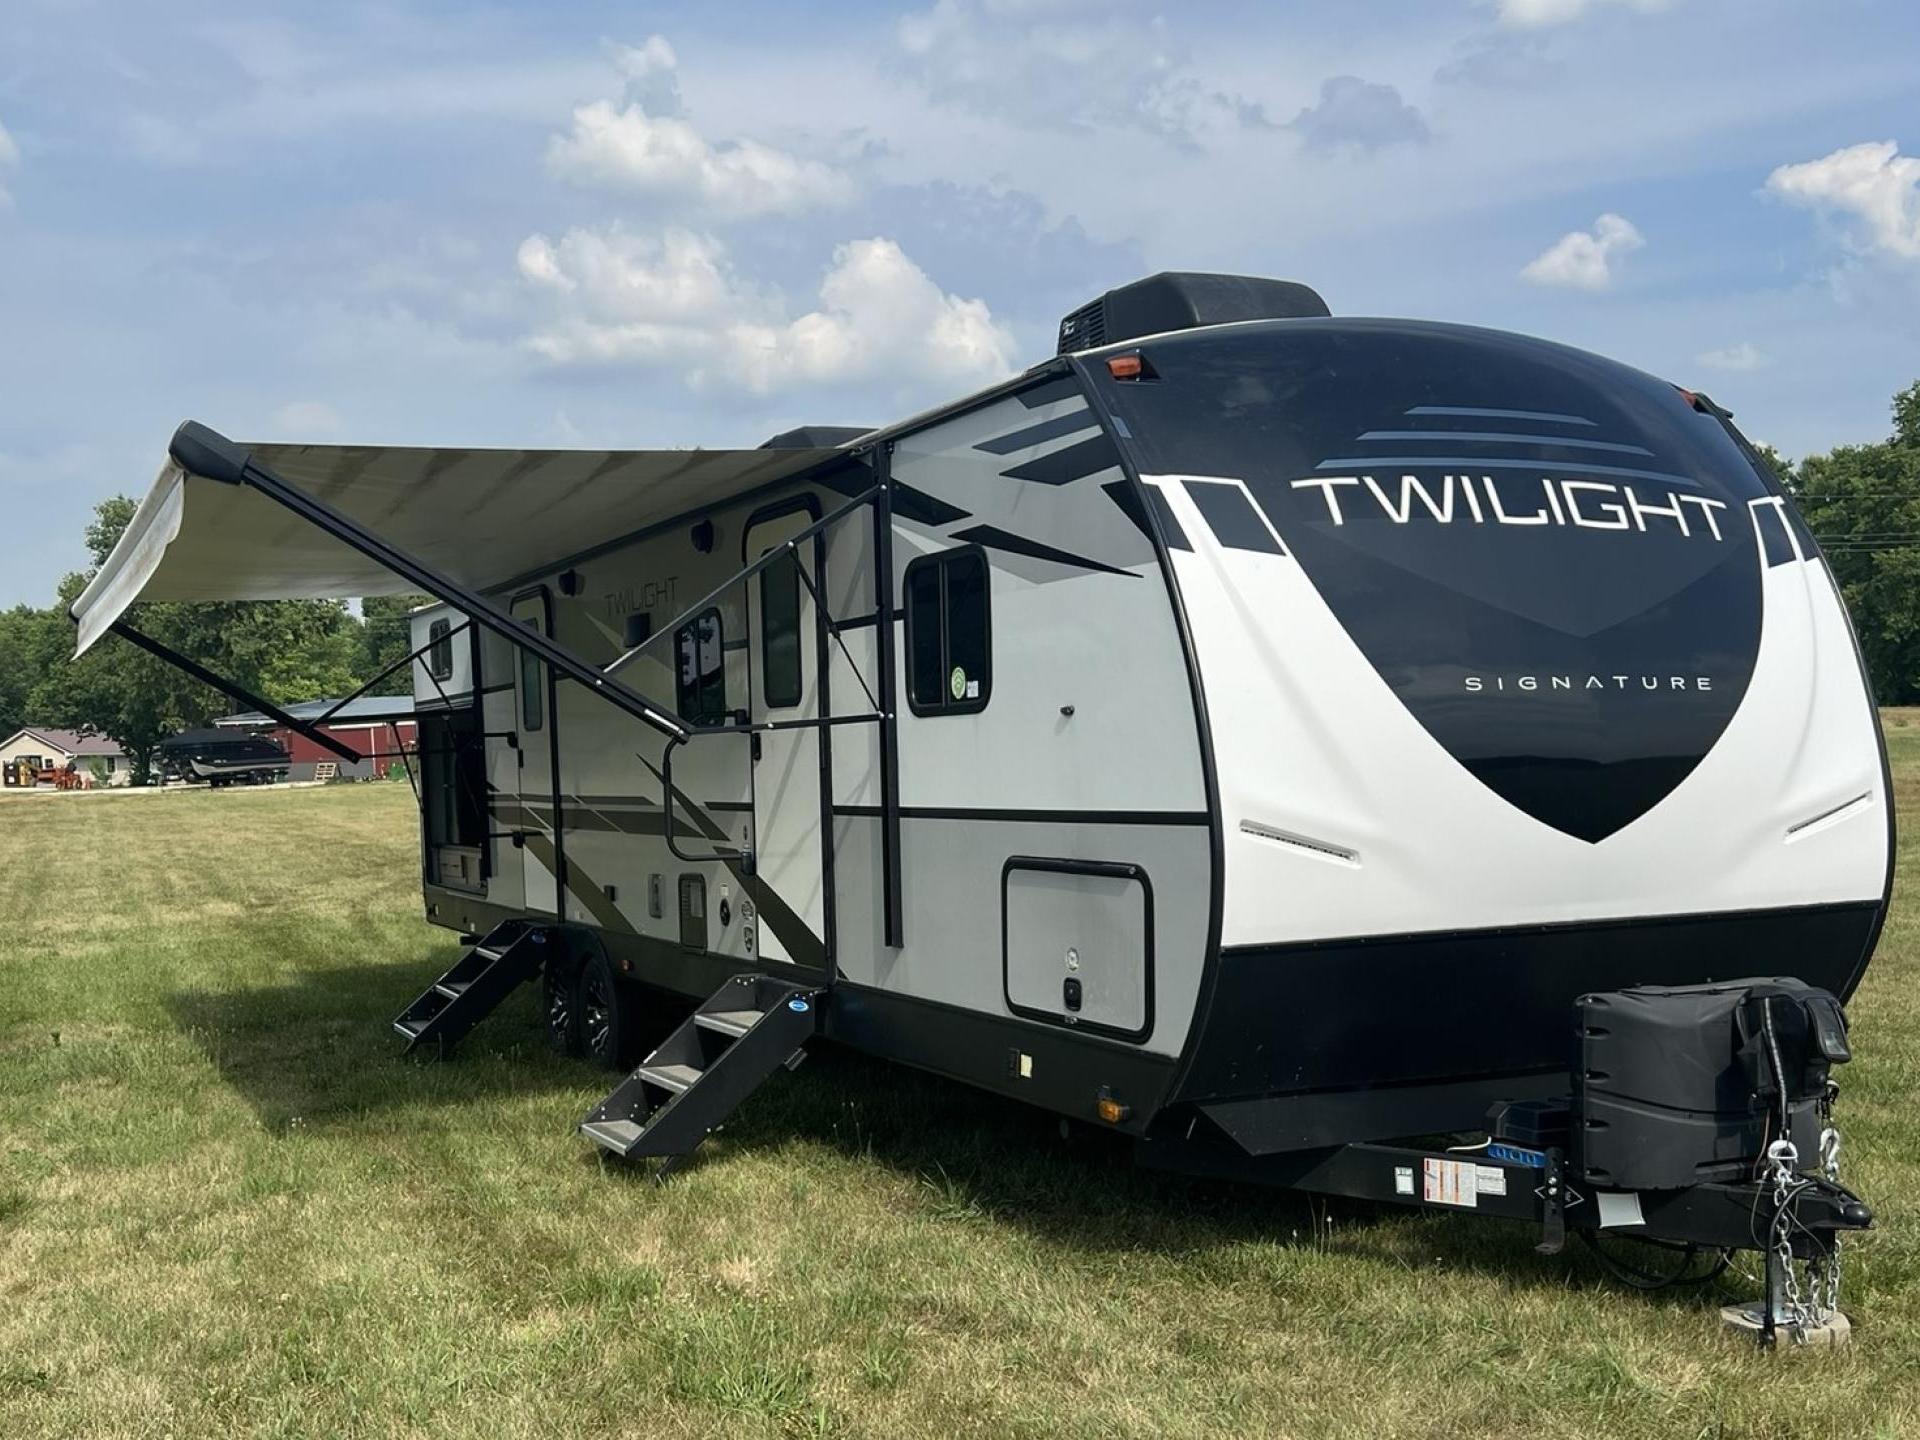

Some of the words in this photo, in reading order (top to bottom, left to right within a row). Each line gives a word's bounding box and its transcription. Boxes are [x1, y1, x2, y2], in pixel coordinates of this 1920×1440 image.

[1290, 474, 1727, 541] TWILIGHT
[604, 576, 679, 617] TWILIGHT
[1465, 675, 1713, 691] SIGNATURE
